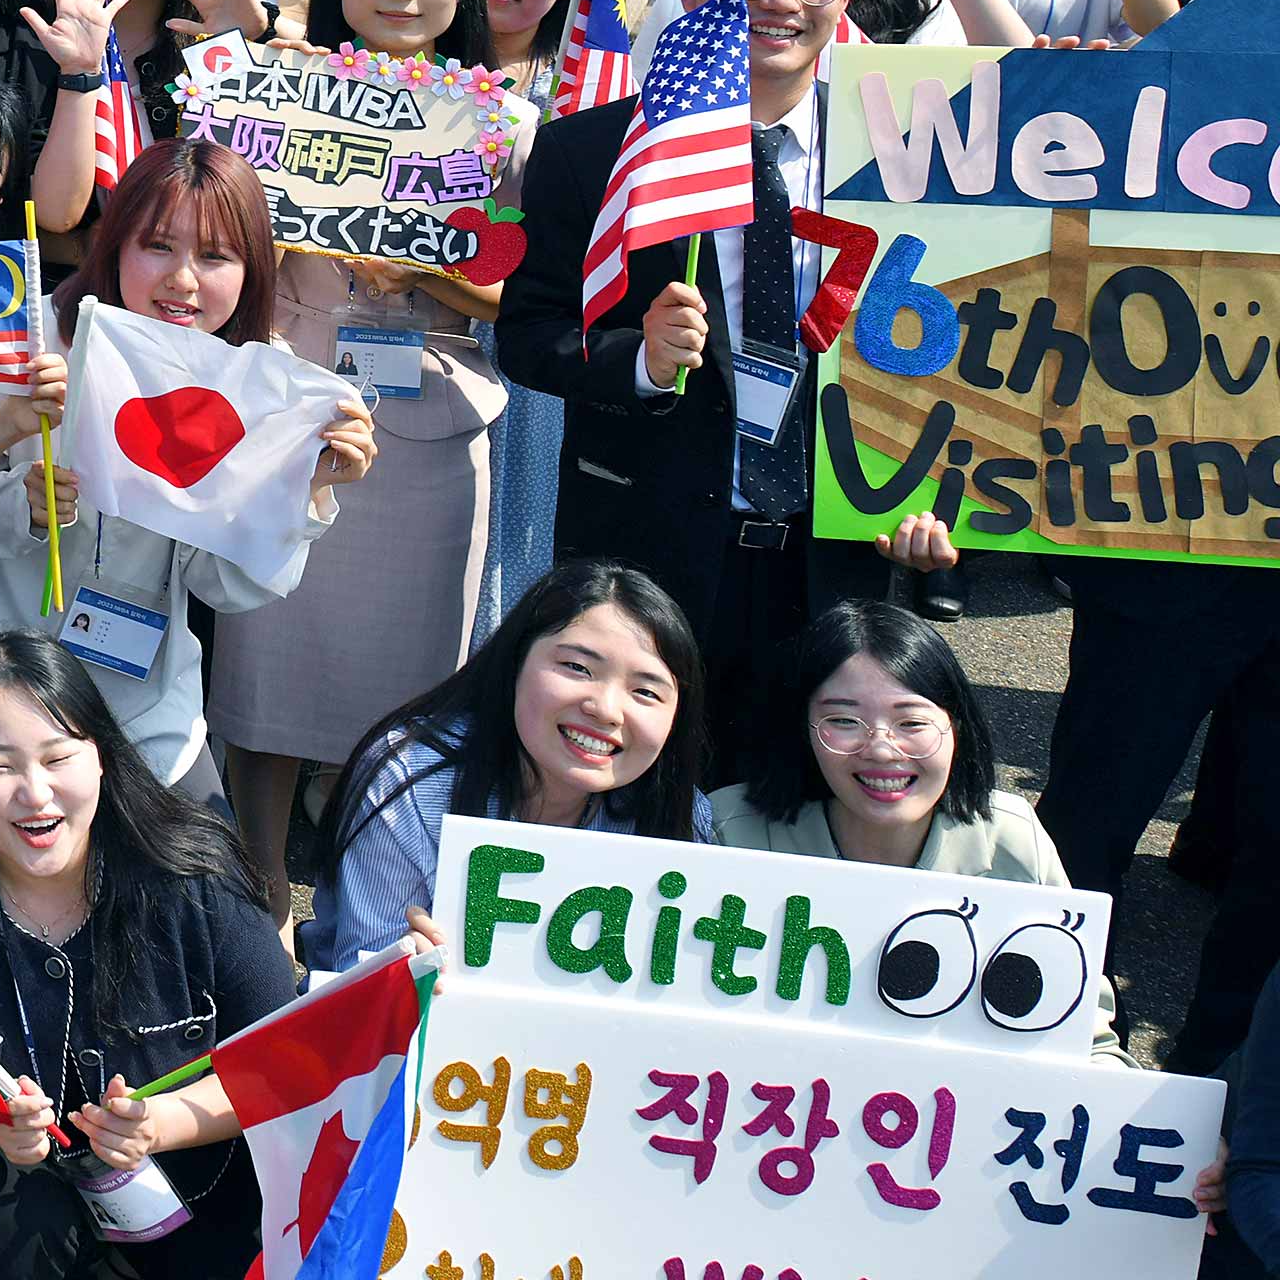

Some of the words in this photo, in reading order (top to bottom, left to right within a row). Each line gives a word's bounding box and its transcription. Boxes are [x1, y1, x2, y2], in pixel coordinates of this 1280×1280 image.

[303, 72, 426, 130] IWBA
[859, 60, 1280, 210] Welc
[463, 844, 853, 1007] Faith
[409, 1055, 593, 1171] 억명
[636, 1068, 958, 1212] 직장인
[994, 1103, 1202, 1227] 전도
